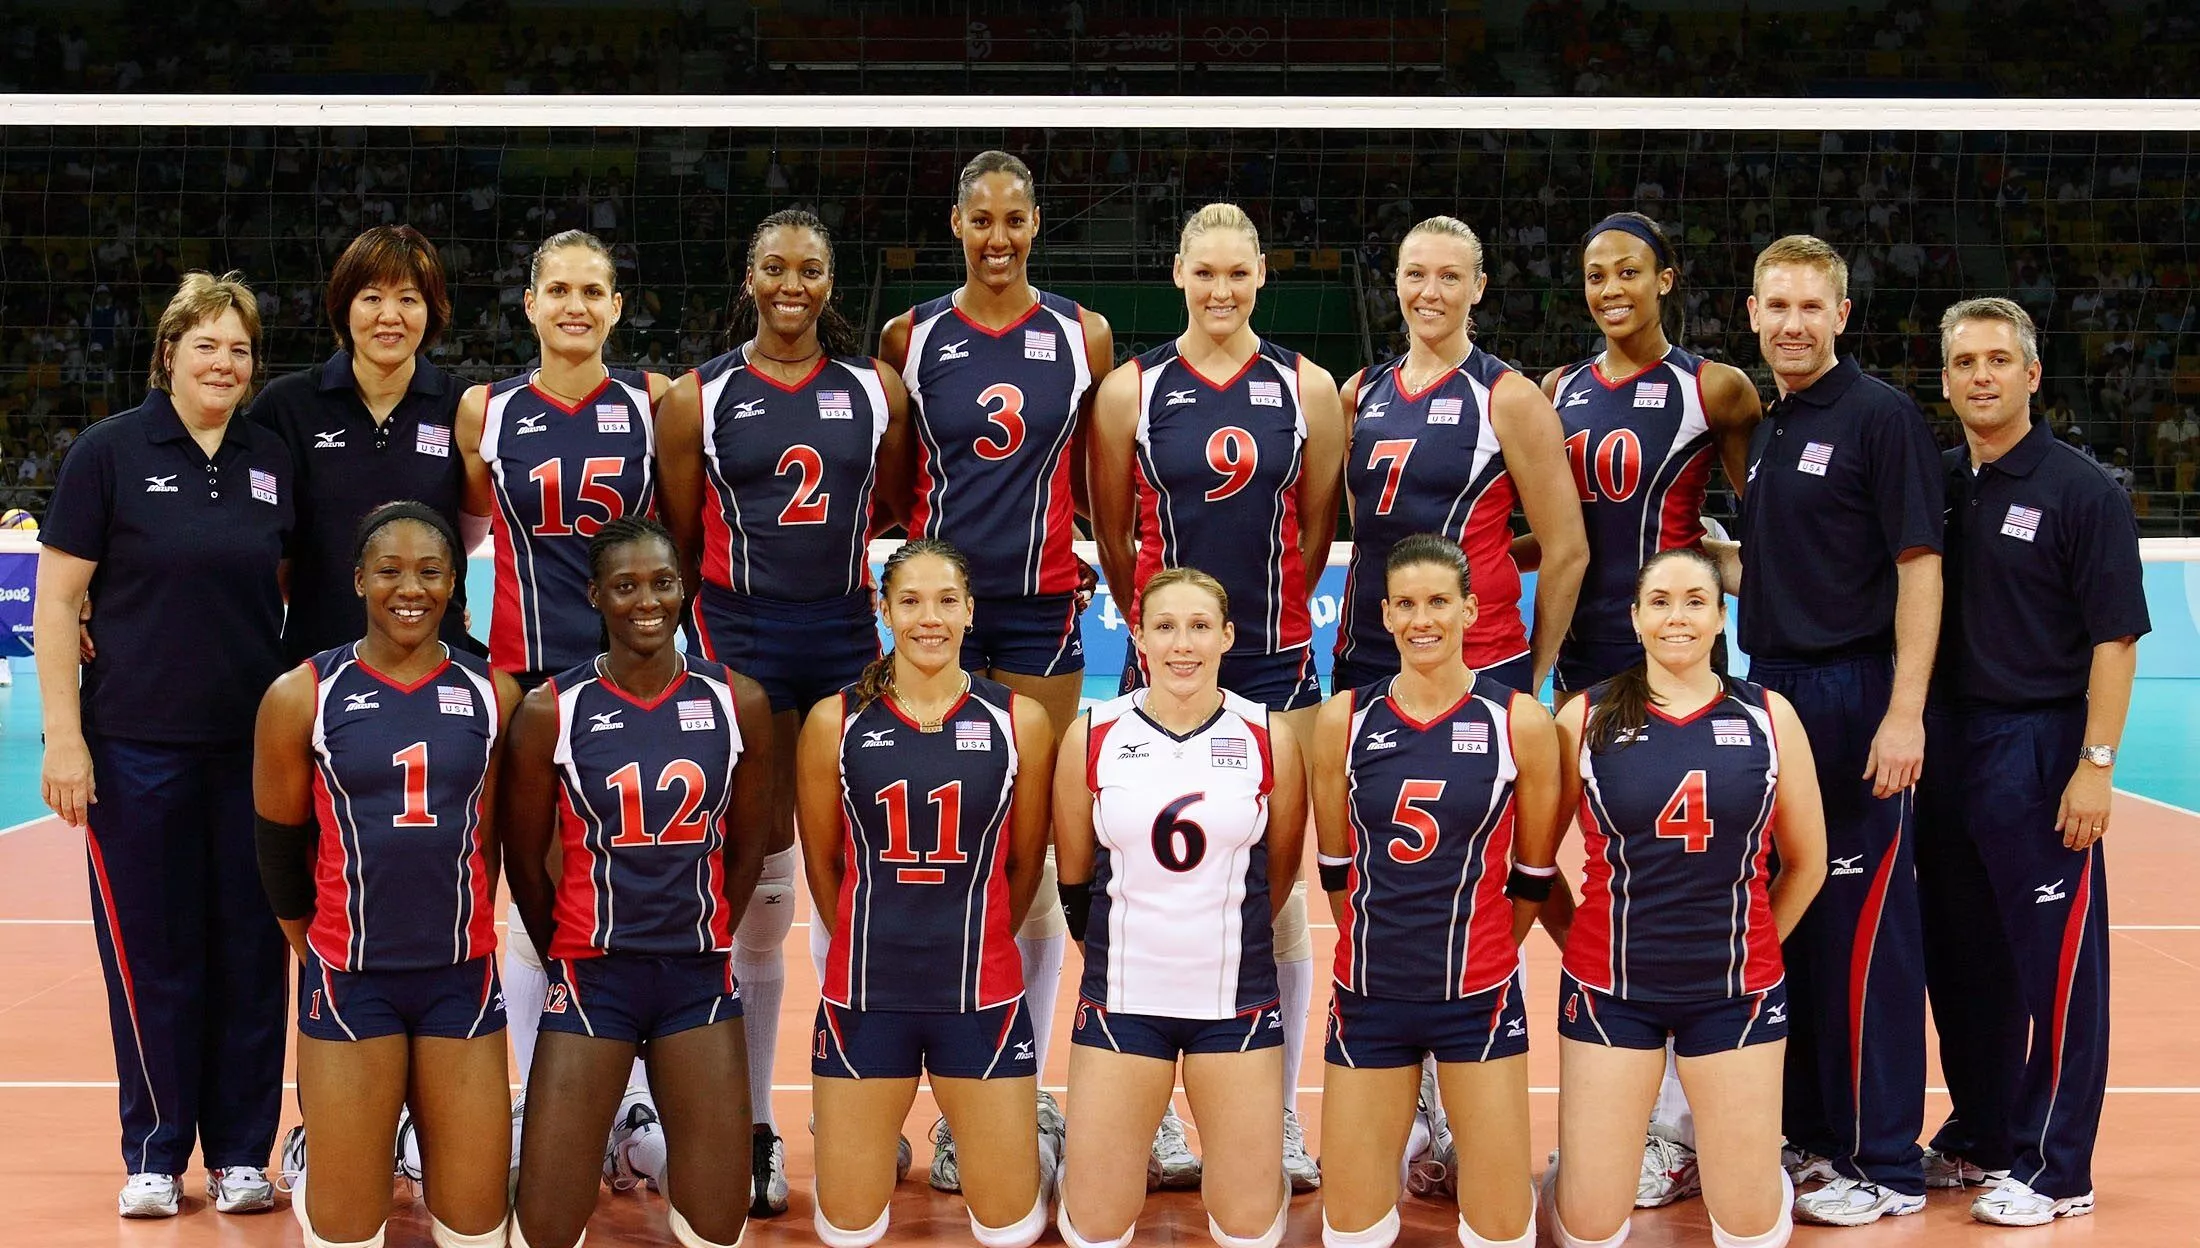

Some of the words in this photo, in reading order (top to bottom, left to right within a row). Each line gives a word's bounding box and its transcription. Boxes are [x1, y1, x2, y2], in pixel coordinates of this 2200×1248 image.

[1029, 350, 1051, 359] USA
[1255, 396, 1277, 404] USA
[1638, 399, 1660, 407] USA
[825, 410, 848, 418] USA
[972, 383, 1027, 461] 3
[1432, 414, 1454, 423] USA
[421, 446, 443, 455] USA
[1204, 425, 1259, 502] 9
[1366, 439, 1418, 515] 7
[1564, 428, 1642, 502] 10
[1802, 463, 1823, 473] USA
[256, 490, 273, 502] USA
[529, 457, 625, 537] 15
[774, 444, 830, 526] 2
[2007, 526, 2029, 538] USA
[0, 587, 30, 602] 2008
[1125, 666, 1136, 692] 9
[445, 705, 469, 714] USA
[686, 720, 710, 729] USA
[962, 741, 985, 749] USA
[1458, 743, 1481, 751] USA
[1721, 736, 1745, 744] USA
[1218, 758, 1242, 766] USA
[392, 741, 438, 828] 1
[606, 758, 710, 847] 12
[1655, 770, 1714, 853] 4
[875, 779, 968, 864] 11
[1151, 792, 1207, 873] 6
[1387, 779, 1446, 864] 5
[310, 989, 322, 1020] 1
[544, 983, 568, 1013] 12
[1565, 993, 1578, 1023] 4
[1076, 1002, 1090, 1030] 6
